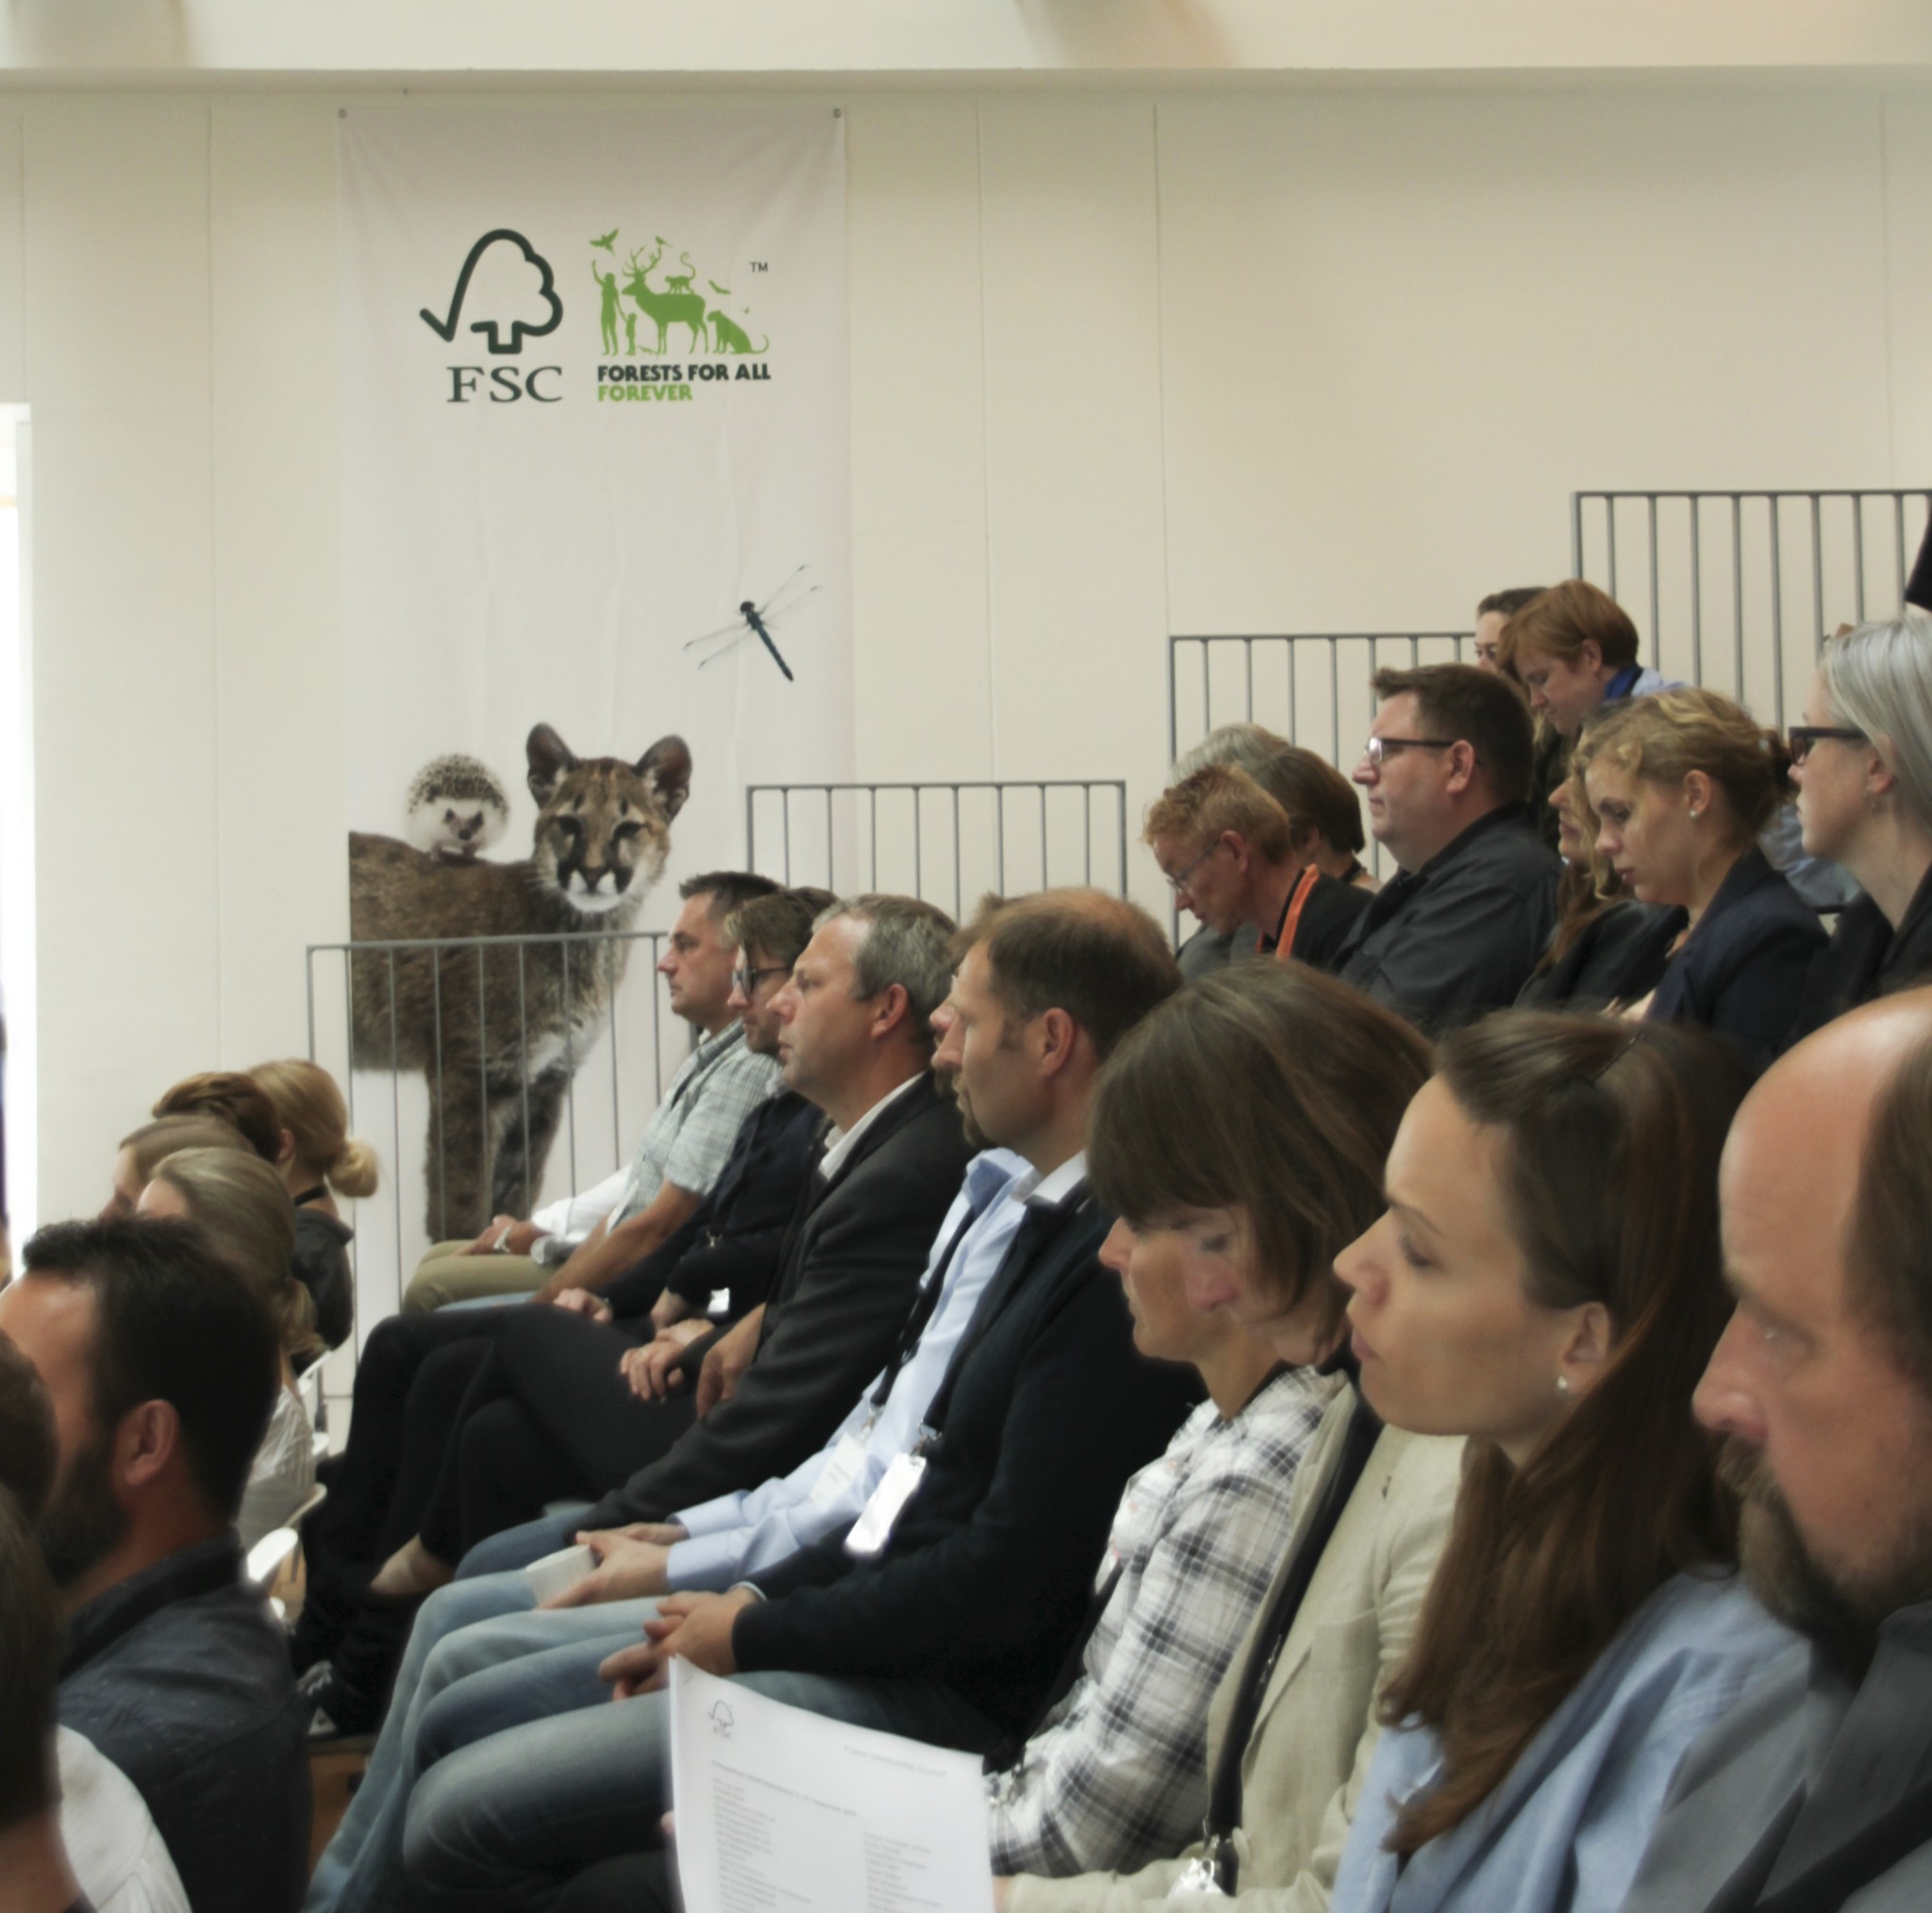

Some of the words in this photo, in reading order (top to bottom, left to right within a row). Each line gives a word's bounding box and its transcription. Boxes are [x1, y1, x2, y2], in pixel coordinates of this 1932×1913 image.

[750, 261, 769, 273] TM
[597, 364, 683, 383] FORESTS
[687, 363, 730, 382] FOR
[734, 362, 772, 381] ALL
[446, 365, 563, 403] FSC
[597, 383, 693, 403] FOREVER
